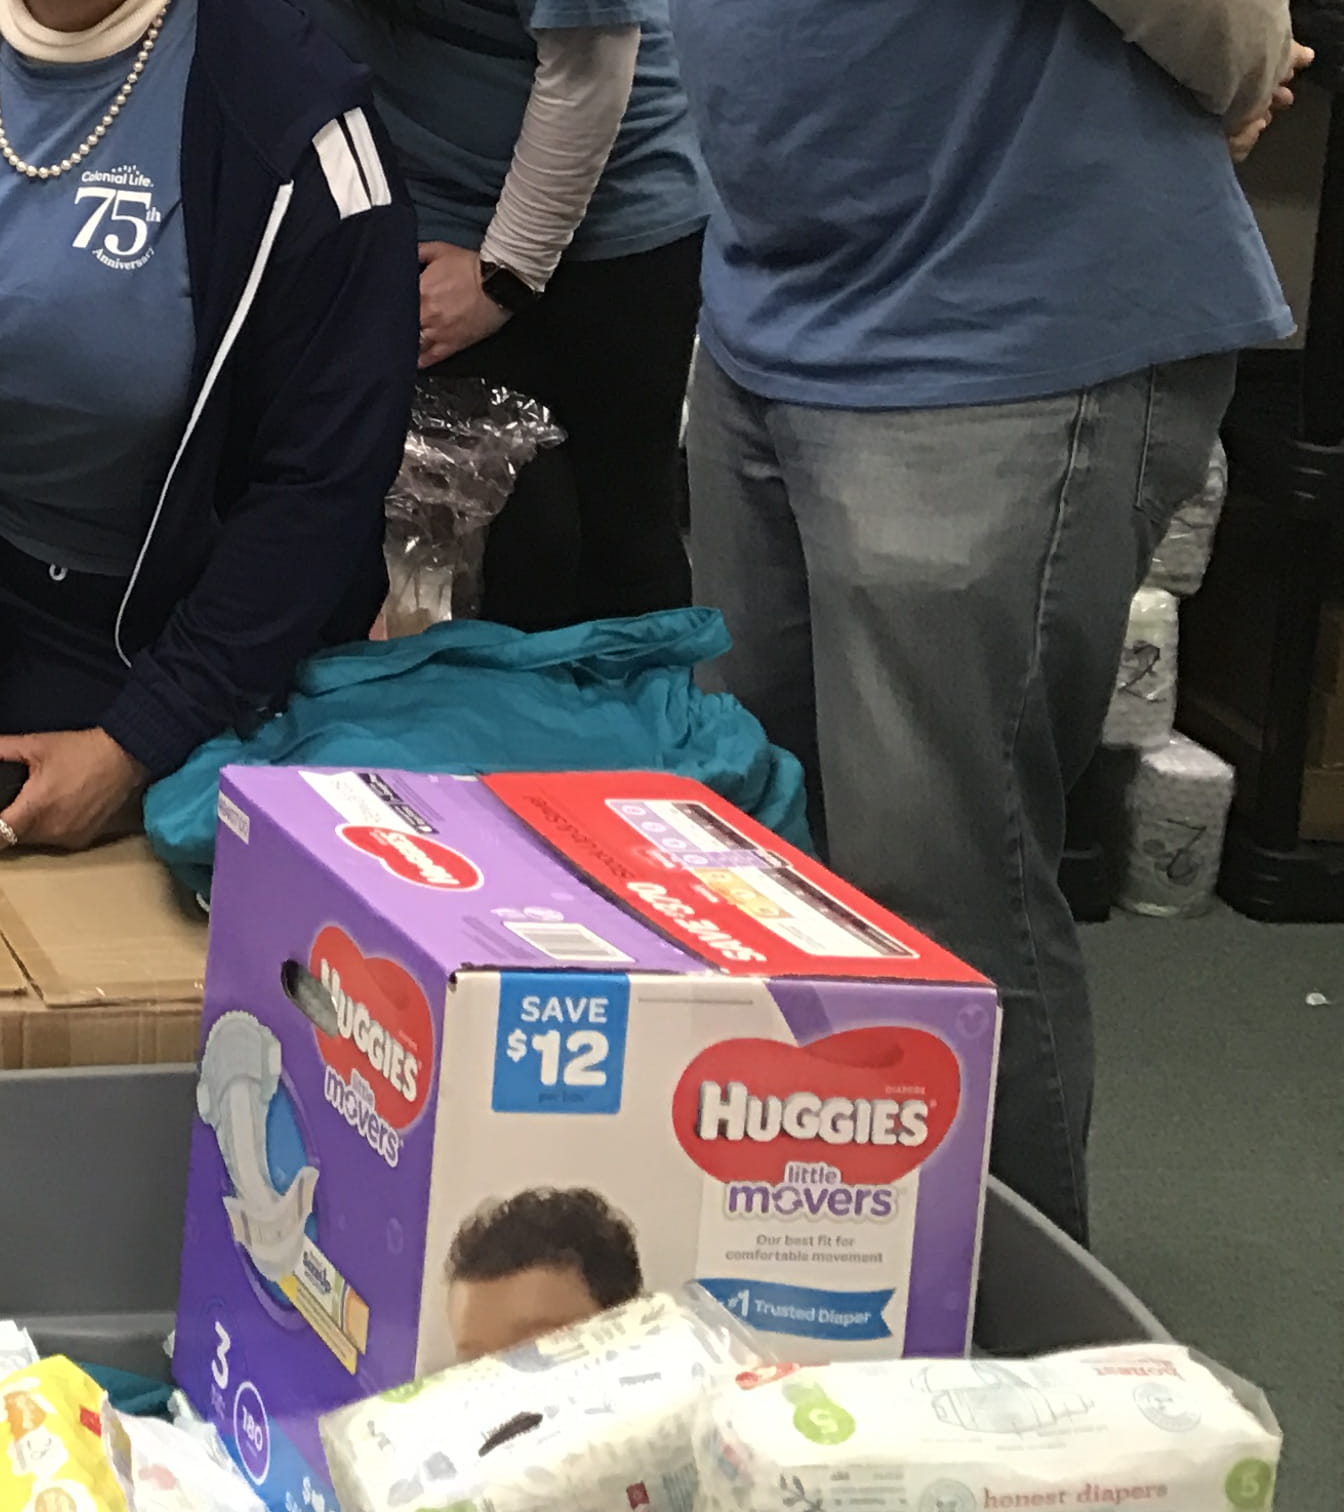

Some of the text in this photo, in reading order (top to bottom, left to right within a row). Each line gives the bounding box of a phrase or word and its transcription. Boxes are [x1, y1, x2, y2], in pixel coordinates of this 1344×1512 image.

[81, 171, 127, 185] Colonial
[92, 247, 155, 270] Anniversary
[520, 995, 610, 1025] SAVE
[320, 957, 418, 1104] HUGGIES
[505, 1028, 610, 1087] $12
[323, 1065, 402, 1168] movers
[698, 1079, 929, 1148] HUGGIES
[786, 1163, 839, 1186] little
[727, 1184, 893, 1217] movers
[725, 1249, 884, 1264] comfortable movement
[755, 1233, 855, 1249] Our best fit for
[727, 1289, 872, 1327] #1 Trusted Diaper
[211, 1320, 231, 1390] 3
[240, 1403, 264, 1452] 180
[983, 1481, 1169, 1511] honest diapers
